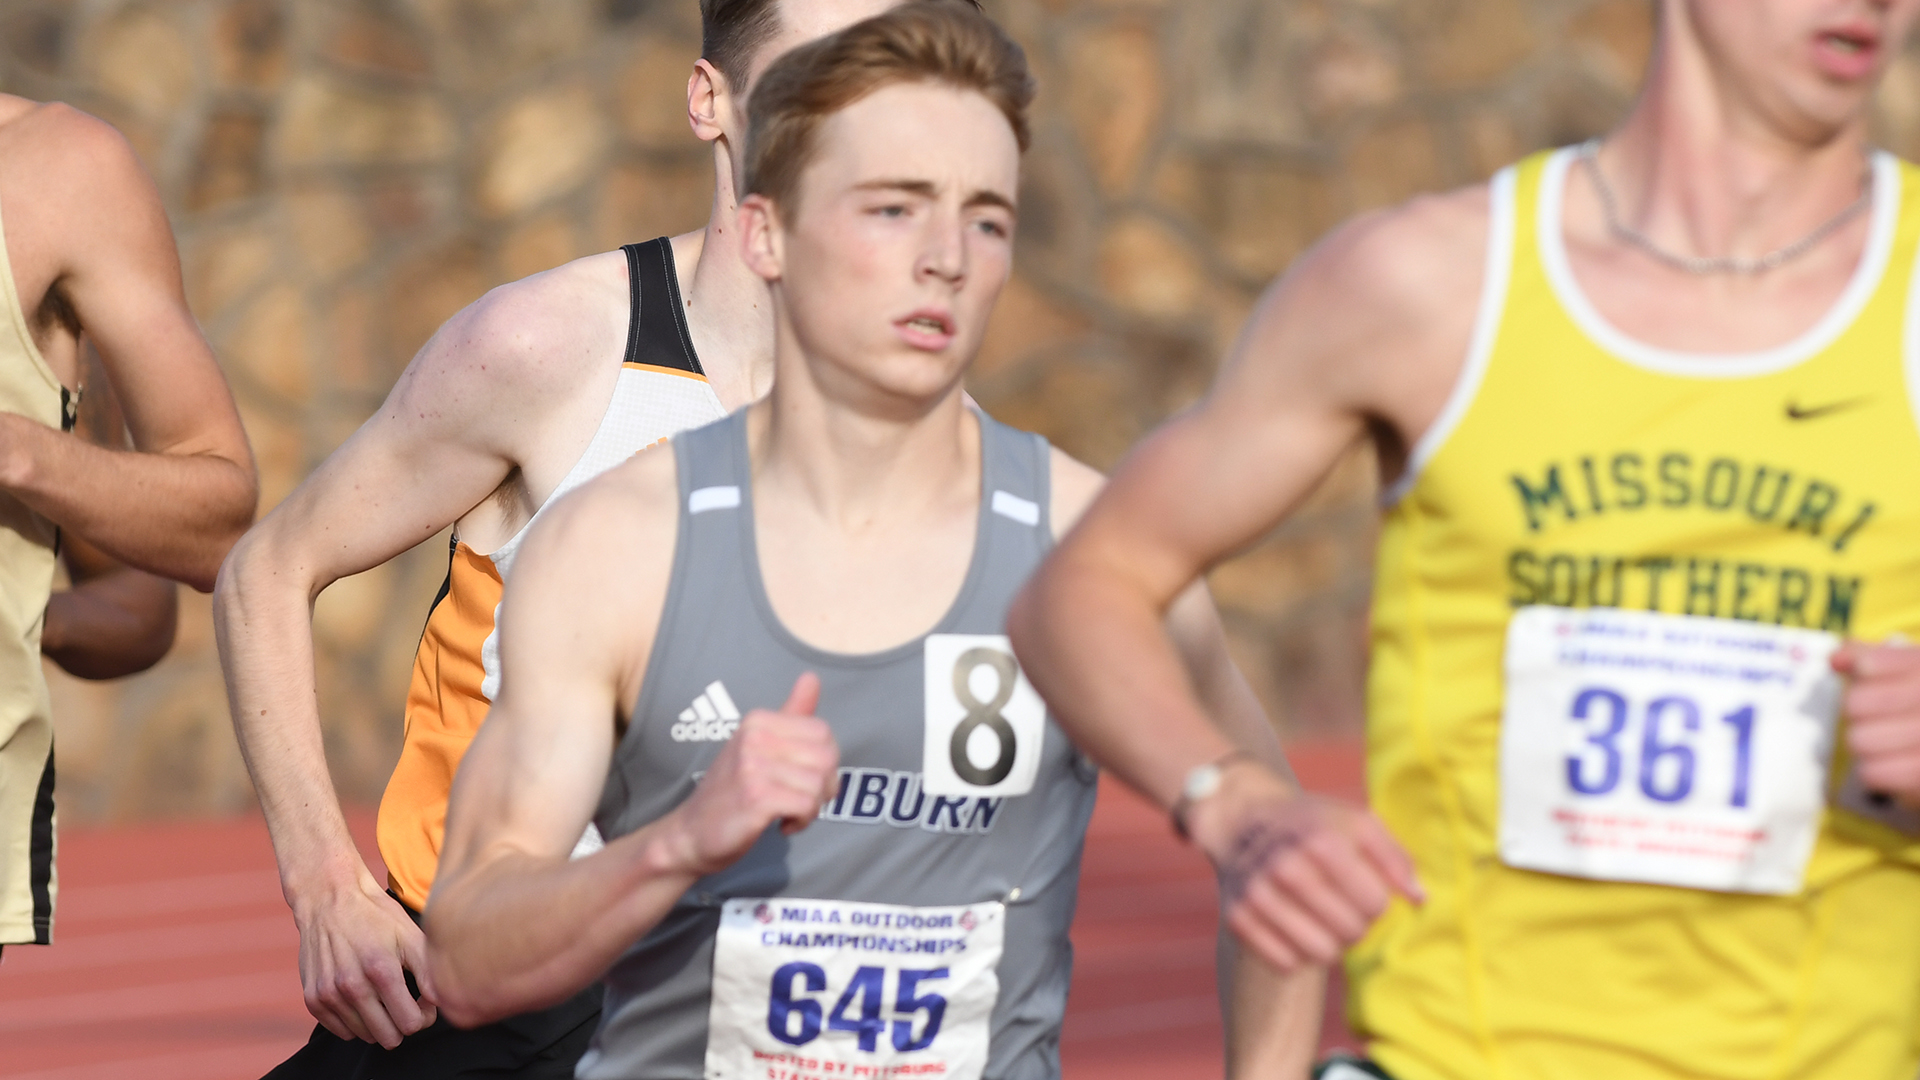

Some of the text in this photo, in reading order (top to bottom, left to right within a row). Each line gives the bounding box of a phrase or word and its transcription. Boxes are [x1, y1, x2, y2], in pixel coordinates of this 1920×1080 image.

[1511, 452, 1877, 553] MISSOURI
[1508, 550, 1860, 634] SOUTHERN
[671, 719, 741, 742] adida
[949, 646, 1018, 787] 8
[1565, 686, 1757, 809] 361
[761, 931, 967, 953] CHAMPIONSHIPS
[781, 907, 953, 928] MIAA OUTDOOR
[767, 961, 950, 1053] 645
